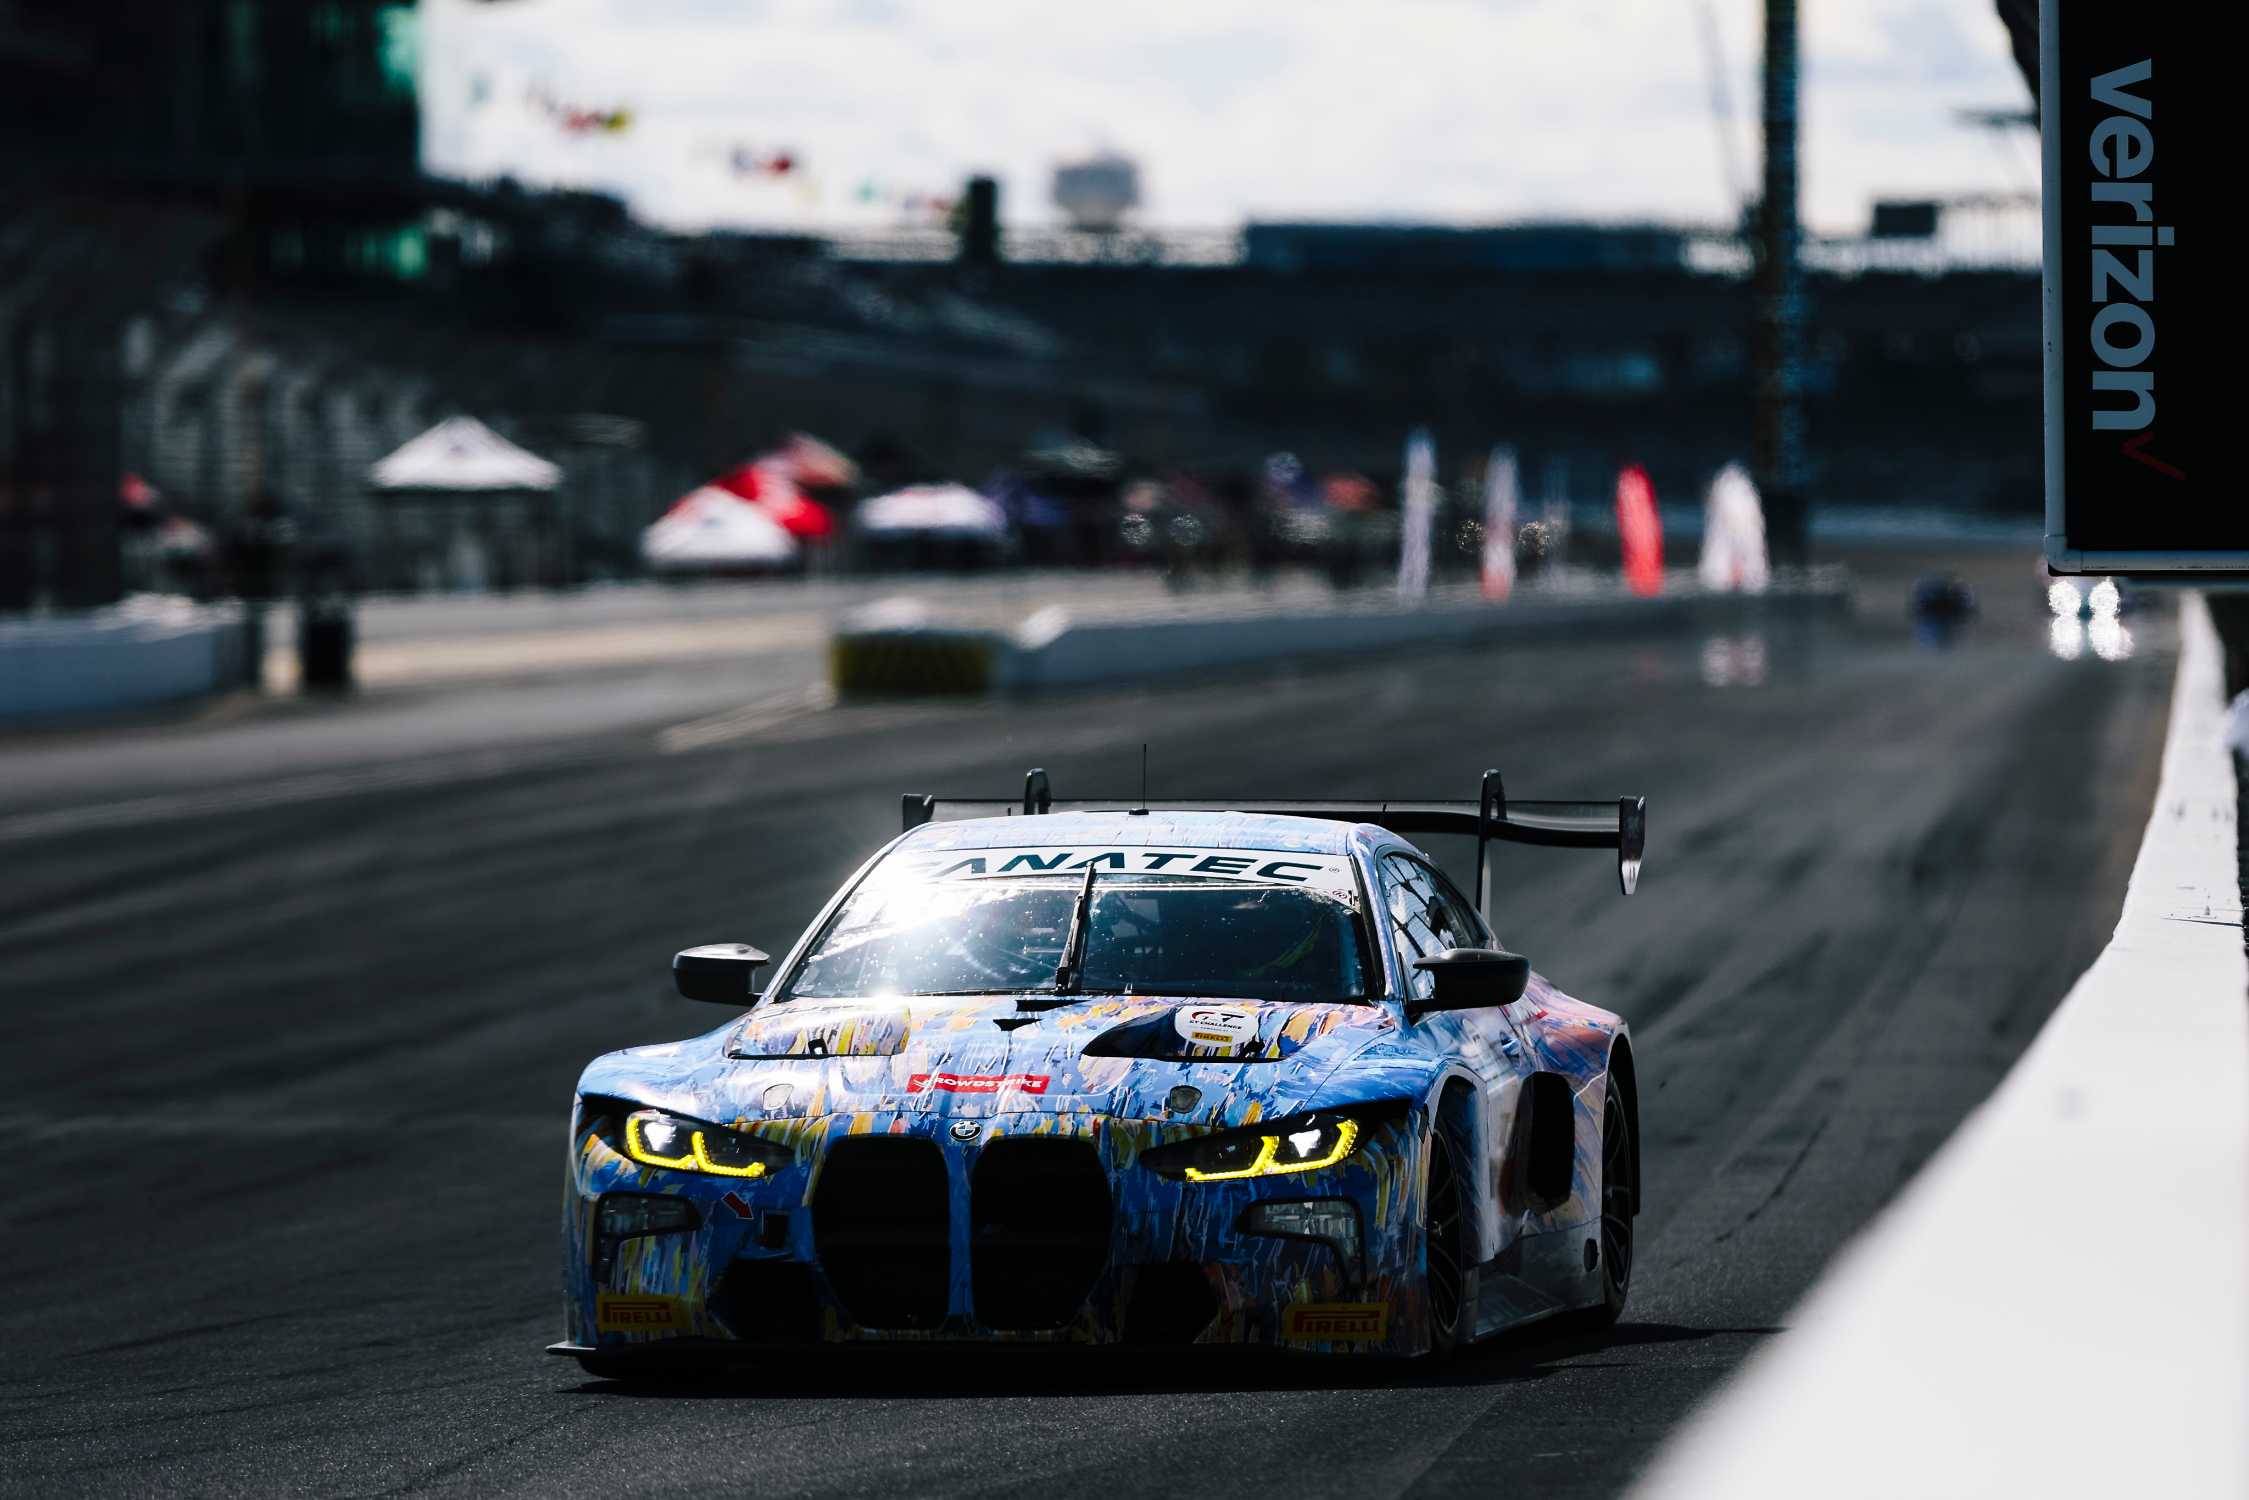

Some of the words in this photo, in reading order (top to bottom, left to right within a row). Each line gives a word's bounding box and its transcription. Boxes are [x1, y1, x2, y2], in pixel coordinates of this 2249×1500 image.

[2089, 57, 2175, 431] verizon
[603, 1302, 672, 1323] PIRELLI
[1294, 1310, 1380, 1332] PIRELLI
